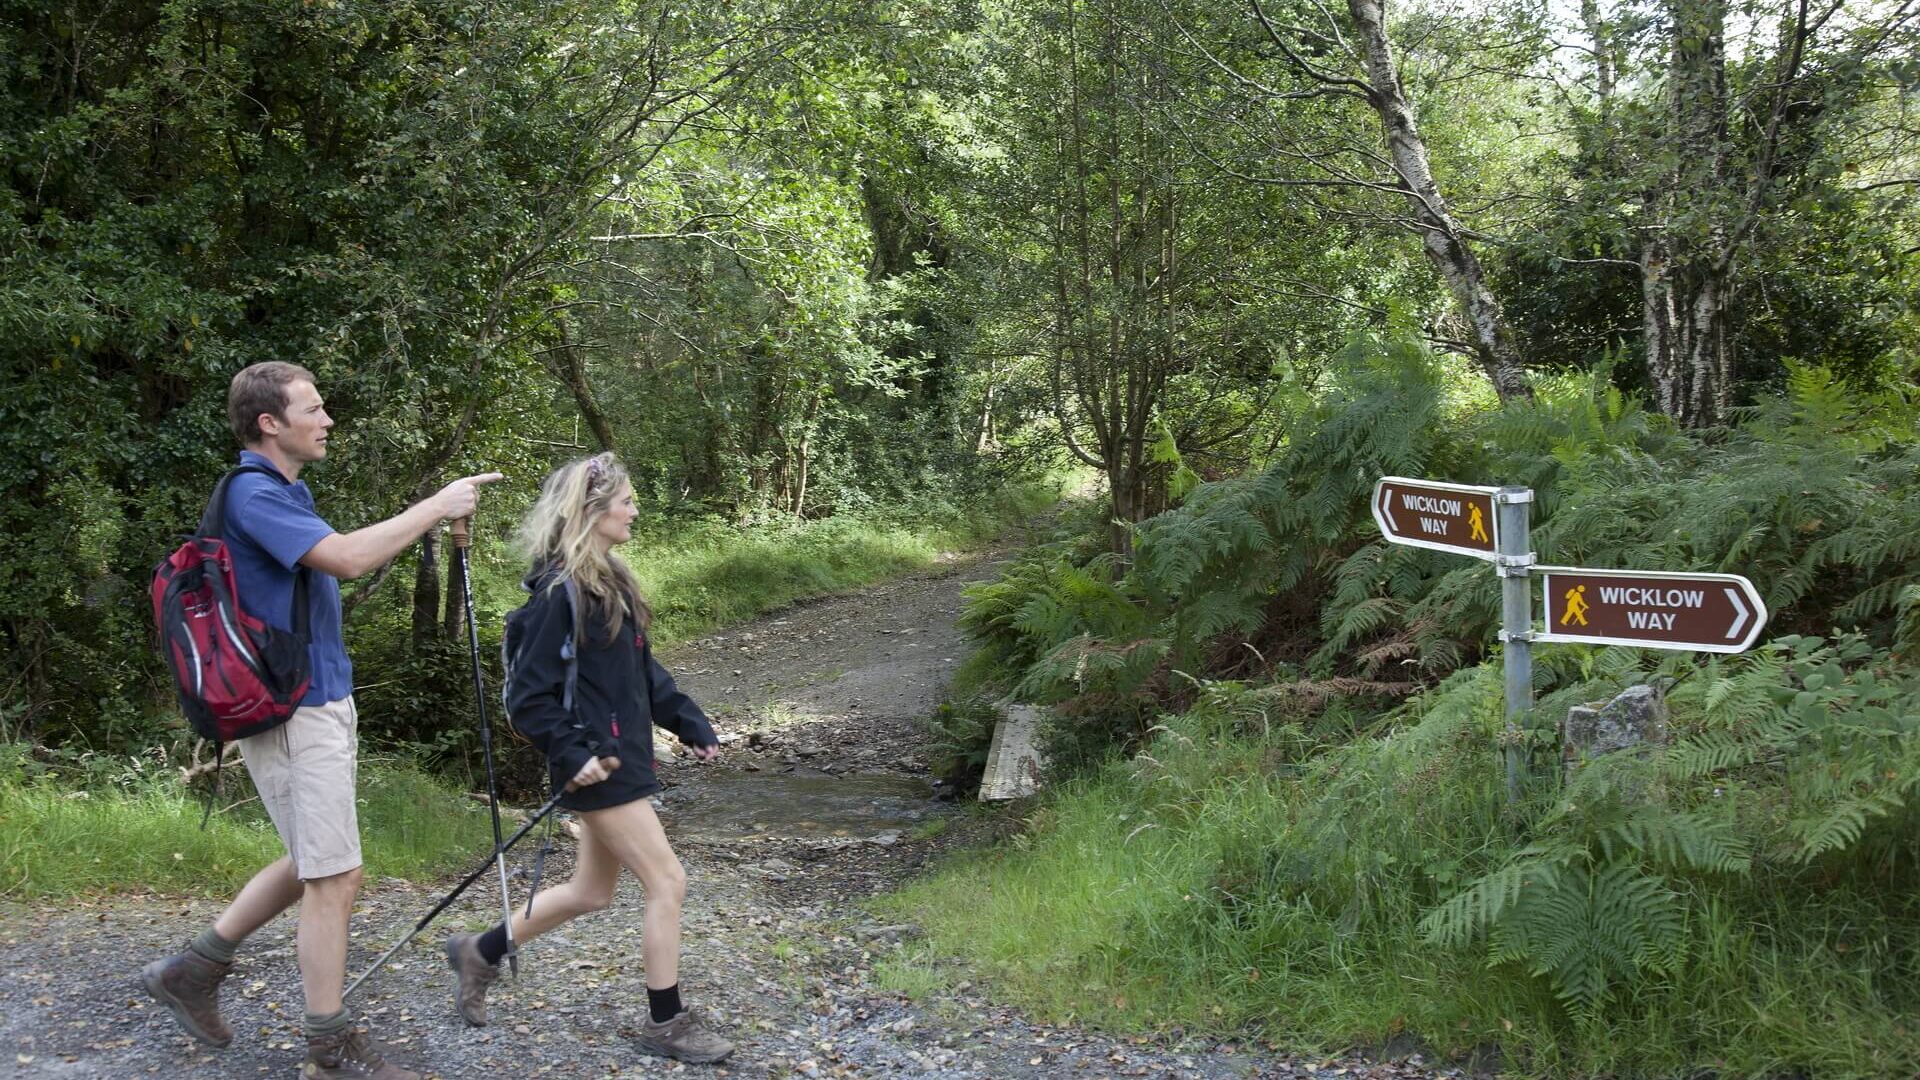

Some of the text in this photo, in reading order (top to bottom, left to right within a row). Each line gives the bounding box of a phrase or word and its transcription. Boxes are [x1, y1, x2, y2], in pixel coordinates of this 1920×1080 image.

[1402, 494, 1461, 516] WICKLOW
[1420, 517, 1447, 535] WAY
[1600, 587, 1704, 608] WICKLOW
[1628, 611, 1675, 630] WAY
